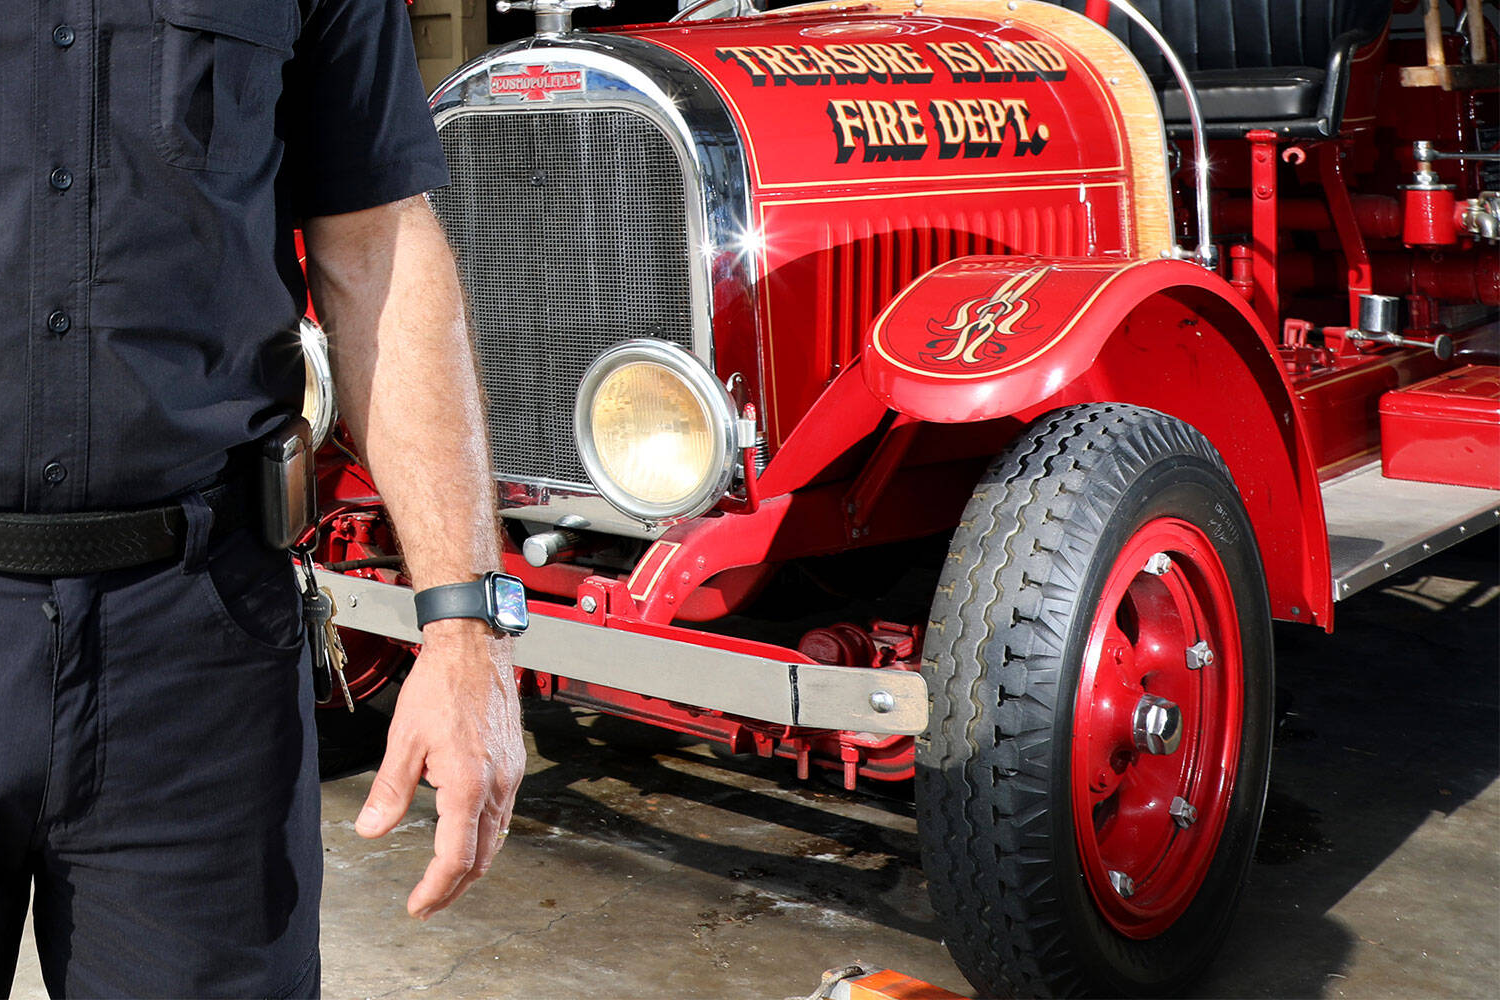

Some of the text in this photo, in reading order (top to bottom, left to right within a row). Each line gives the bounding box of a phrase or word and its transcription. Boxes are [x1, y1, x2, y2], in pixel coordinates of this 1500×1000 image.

[495, 74, 578, 91] COSMOPOLITAN
[716, 40, 1067, 84] TREASURE ISLAND
[827, 98, 1050, 158] FIRE DEPT.
